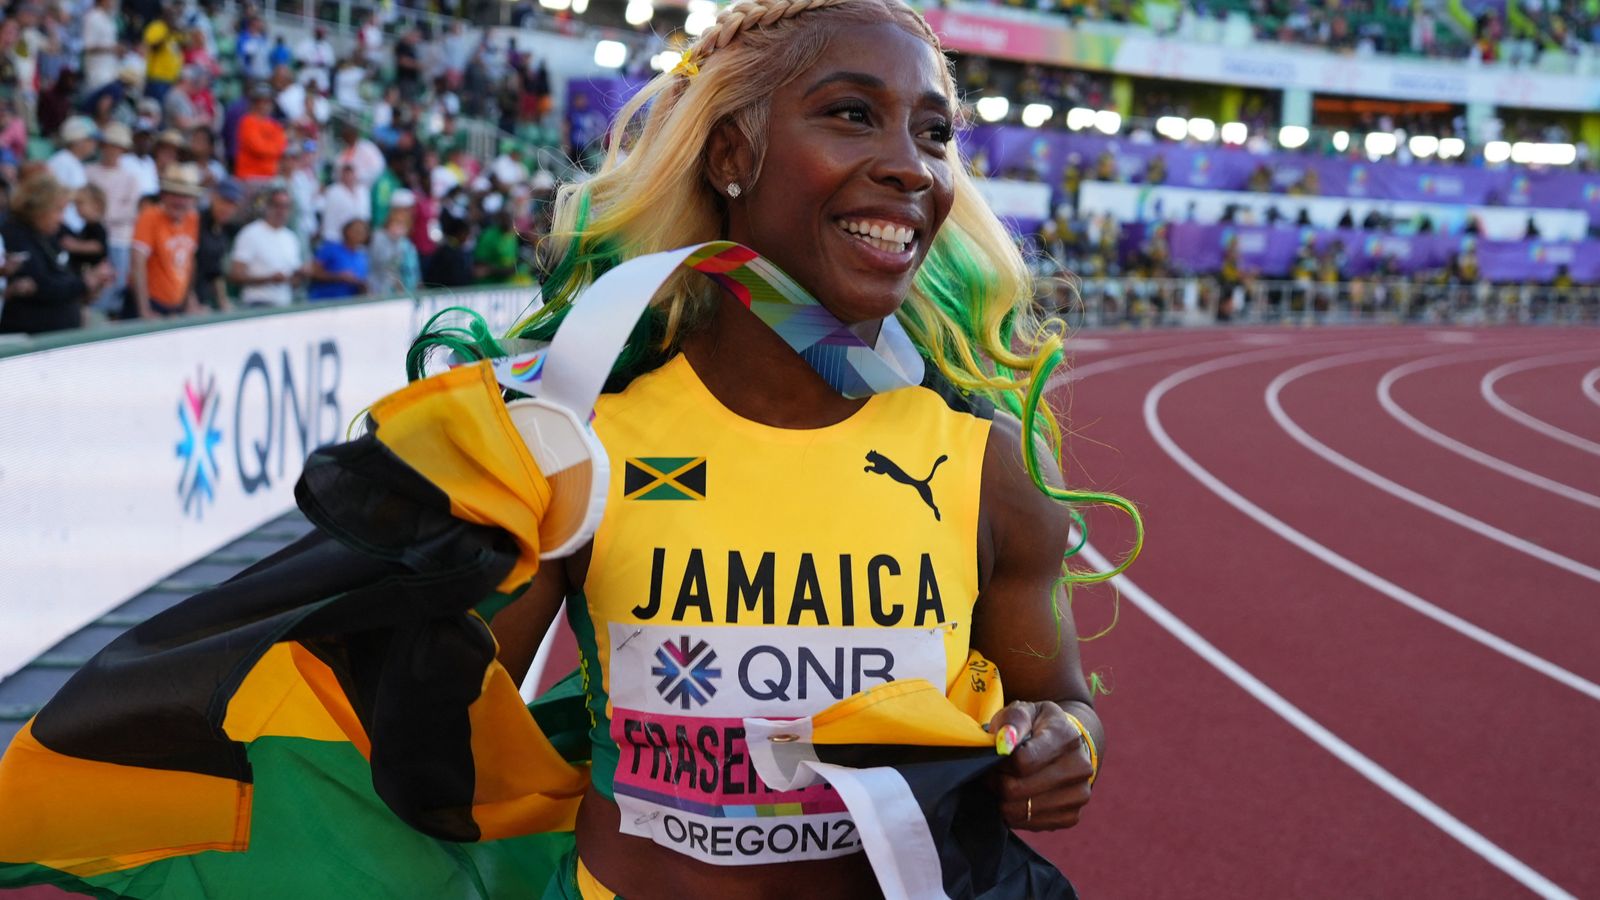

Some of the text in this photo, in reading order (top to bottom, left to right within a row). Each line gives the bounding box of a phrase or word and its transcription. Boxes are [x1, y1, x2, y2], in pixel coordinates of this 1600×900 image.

[234, 340, 341, 494] QNB
[631, 547, 946, 627] JAMAICA
[738, 645, 895, 701] QNB
[624, 718, 771, 795] FRASE
[663, 814, 862, 856] OREGON2
